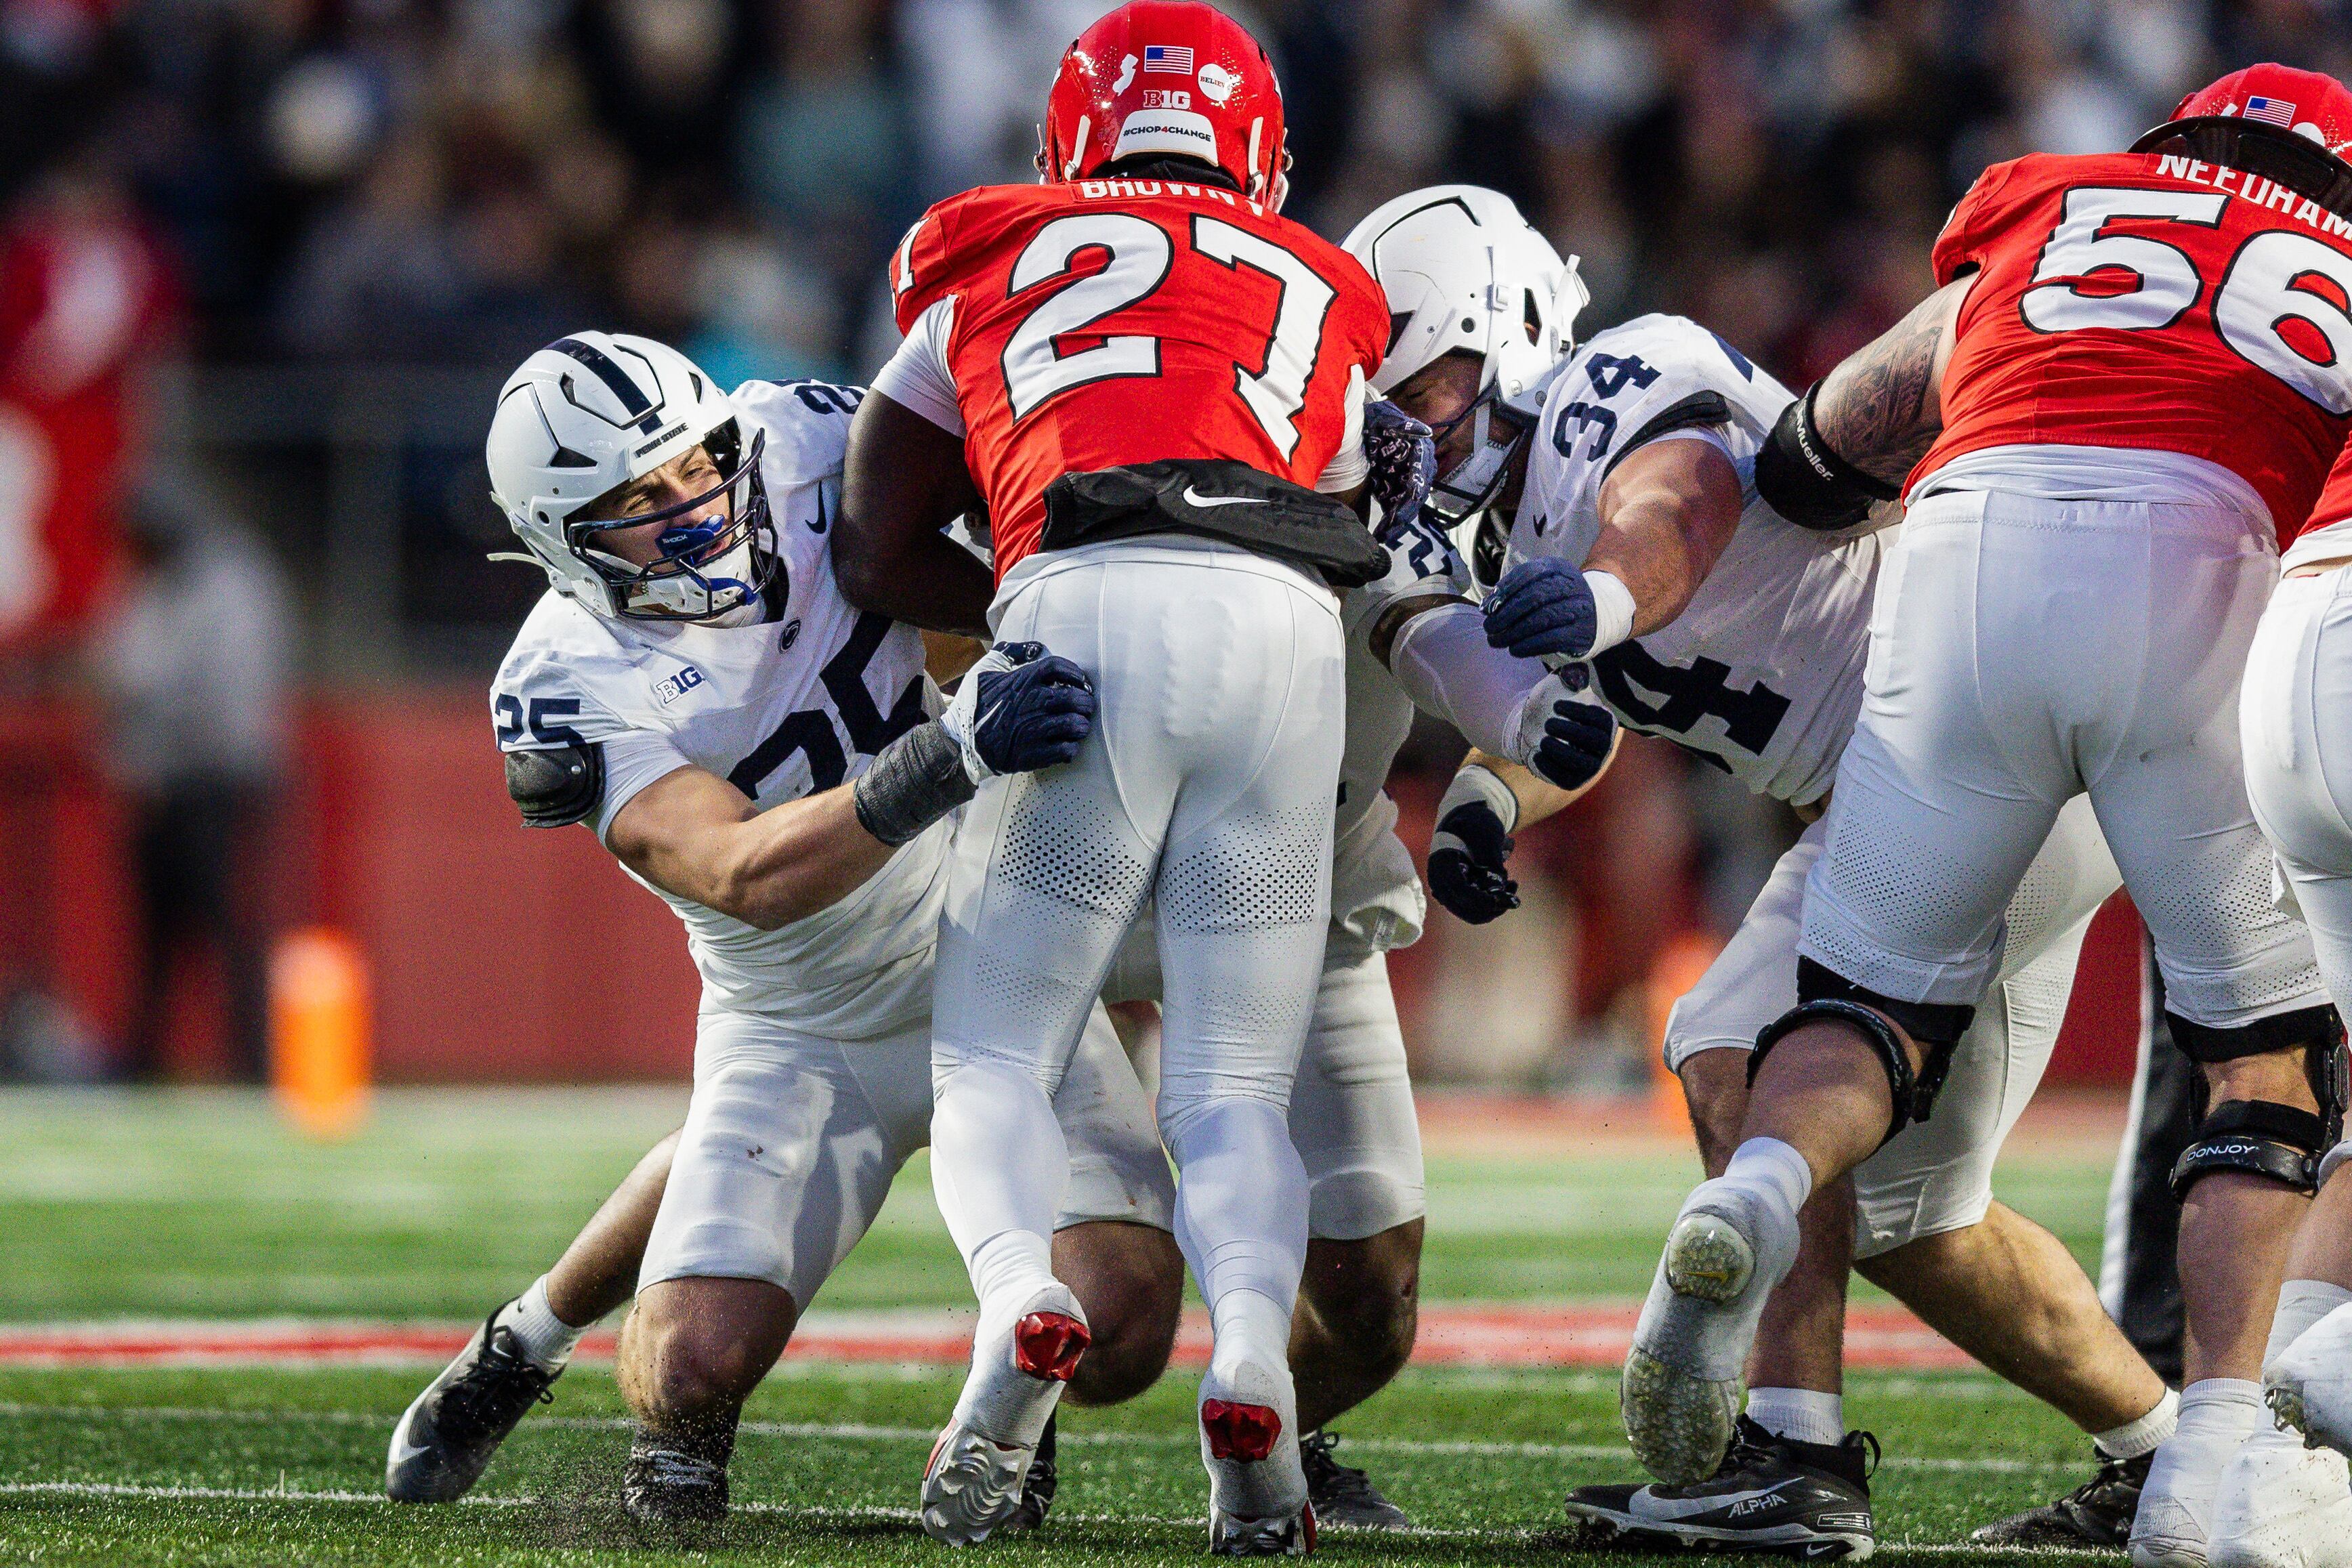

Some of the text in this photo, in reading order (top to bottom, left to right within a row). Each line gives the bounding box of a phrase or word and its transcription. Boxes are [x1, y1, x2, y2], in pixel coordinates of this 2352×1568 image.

[1123, 125, 1211, 142] #CHOP4CHANGE
[2019, 186, 2352, 419] 56
[1001, 212, 1338, 465] 27
[1553, 353, 1662, 462] 34
[661, 422, 690, 443] STATE
[495, 692, 587, 752] 25
[2187, 1145, 2256, 1162] DONJOY
[1728, 1494, 1788, 1519] ALPHA
